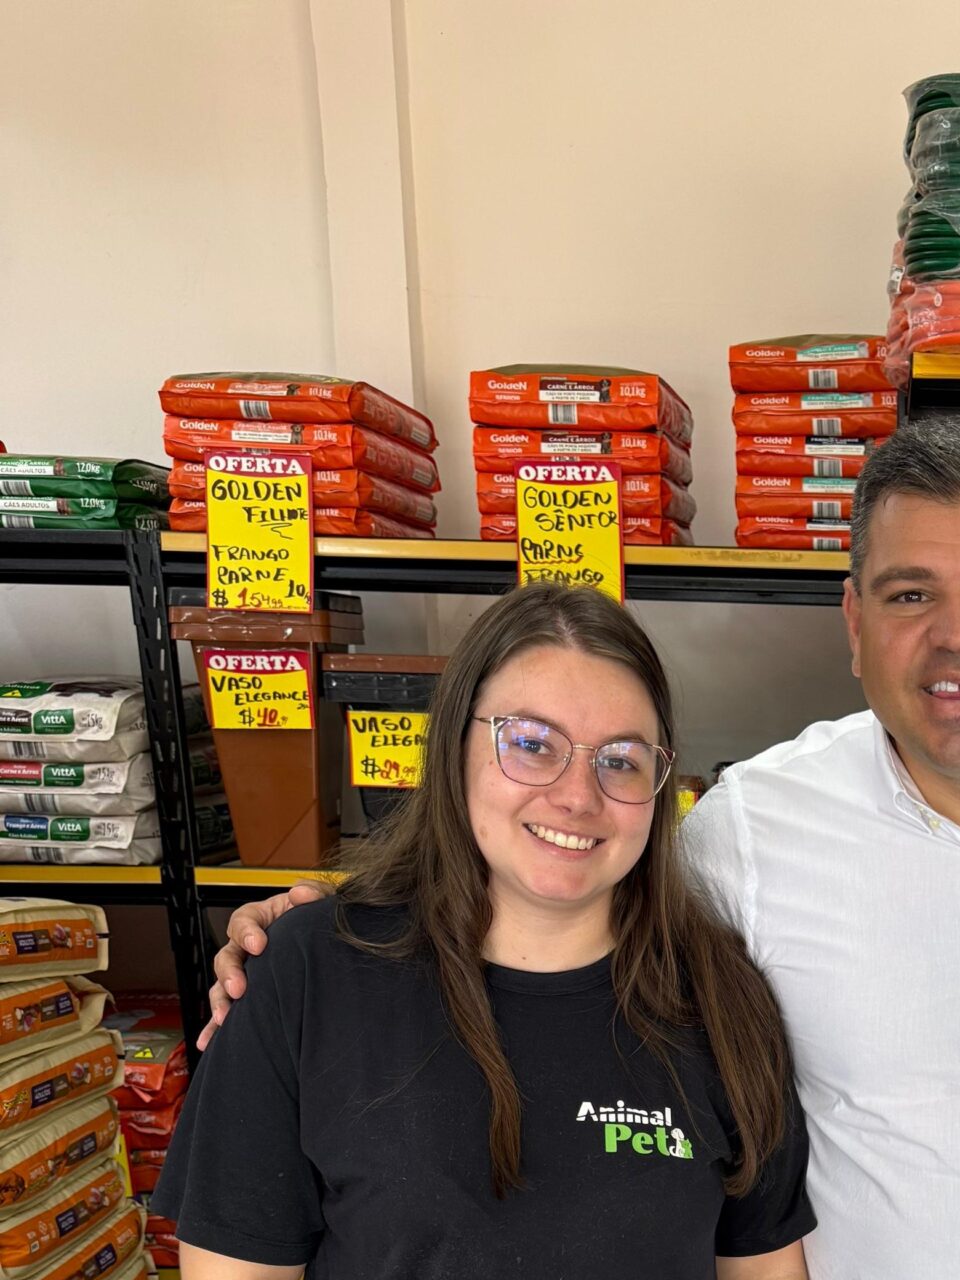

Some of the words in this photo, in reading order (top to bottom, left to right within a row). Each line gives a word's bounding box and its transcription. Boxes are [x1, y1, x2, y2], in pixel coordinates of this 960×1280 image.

[209, 455, 304, 475] OFERTA
[519, 465, 614, 481] OFERTA
[212, 479, 302, 501] GOLDEN
[523, 486, 611, 509] GOLDEN
[212, 545, 289, 561] FRANGO
[209, 655, 304, 671] OFERTA
[211, 675, 262, 692] VASO
[234, 690, 310, 706] ELEGANCE
[239, 707, 255, 727] $
[352, 716, 411, 733] VASO
[361, 755, 381, 781] $
[576, 1099, 673, 1127] Animal
[604, 1123, 671, 1157] Pet
